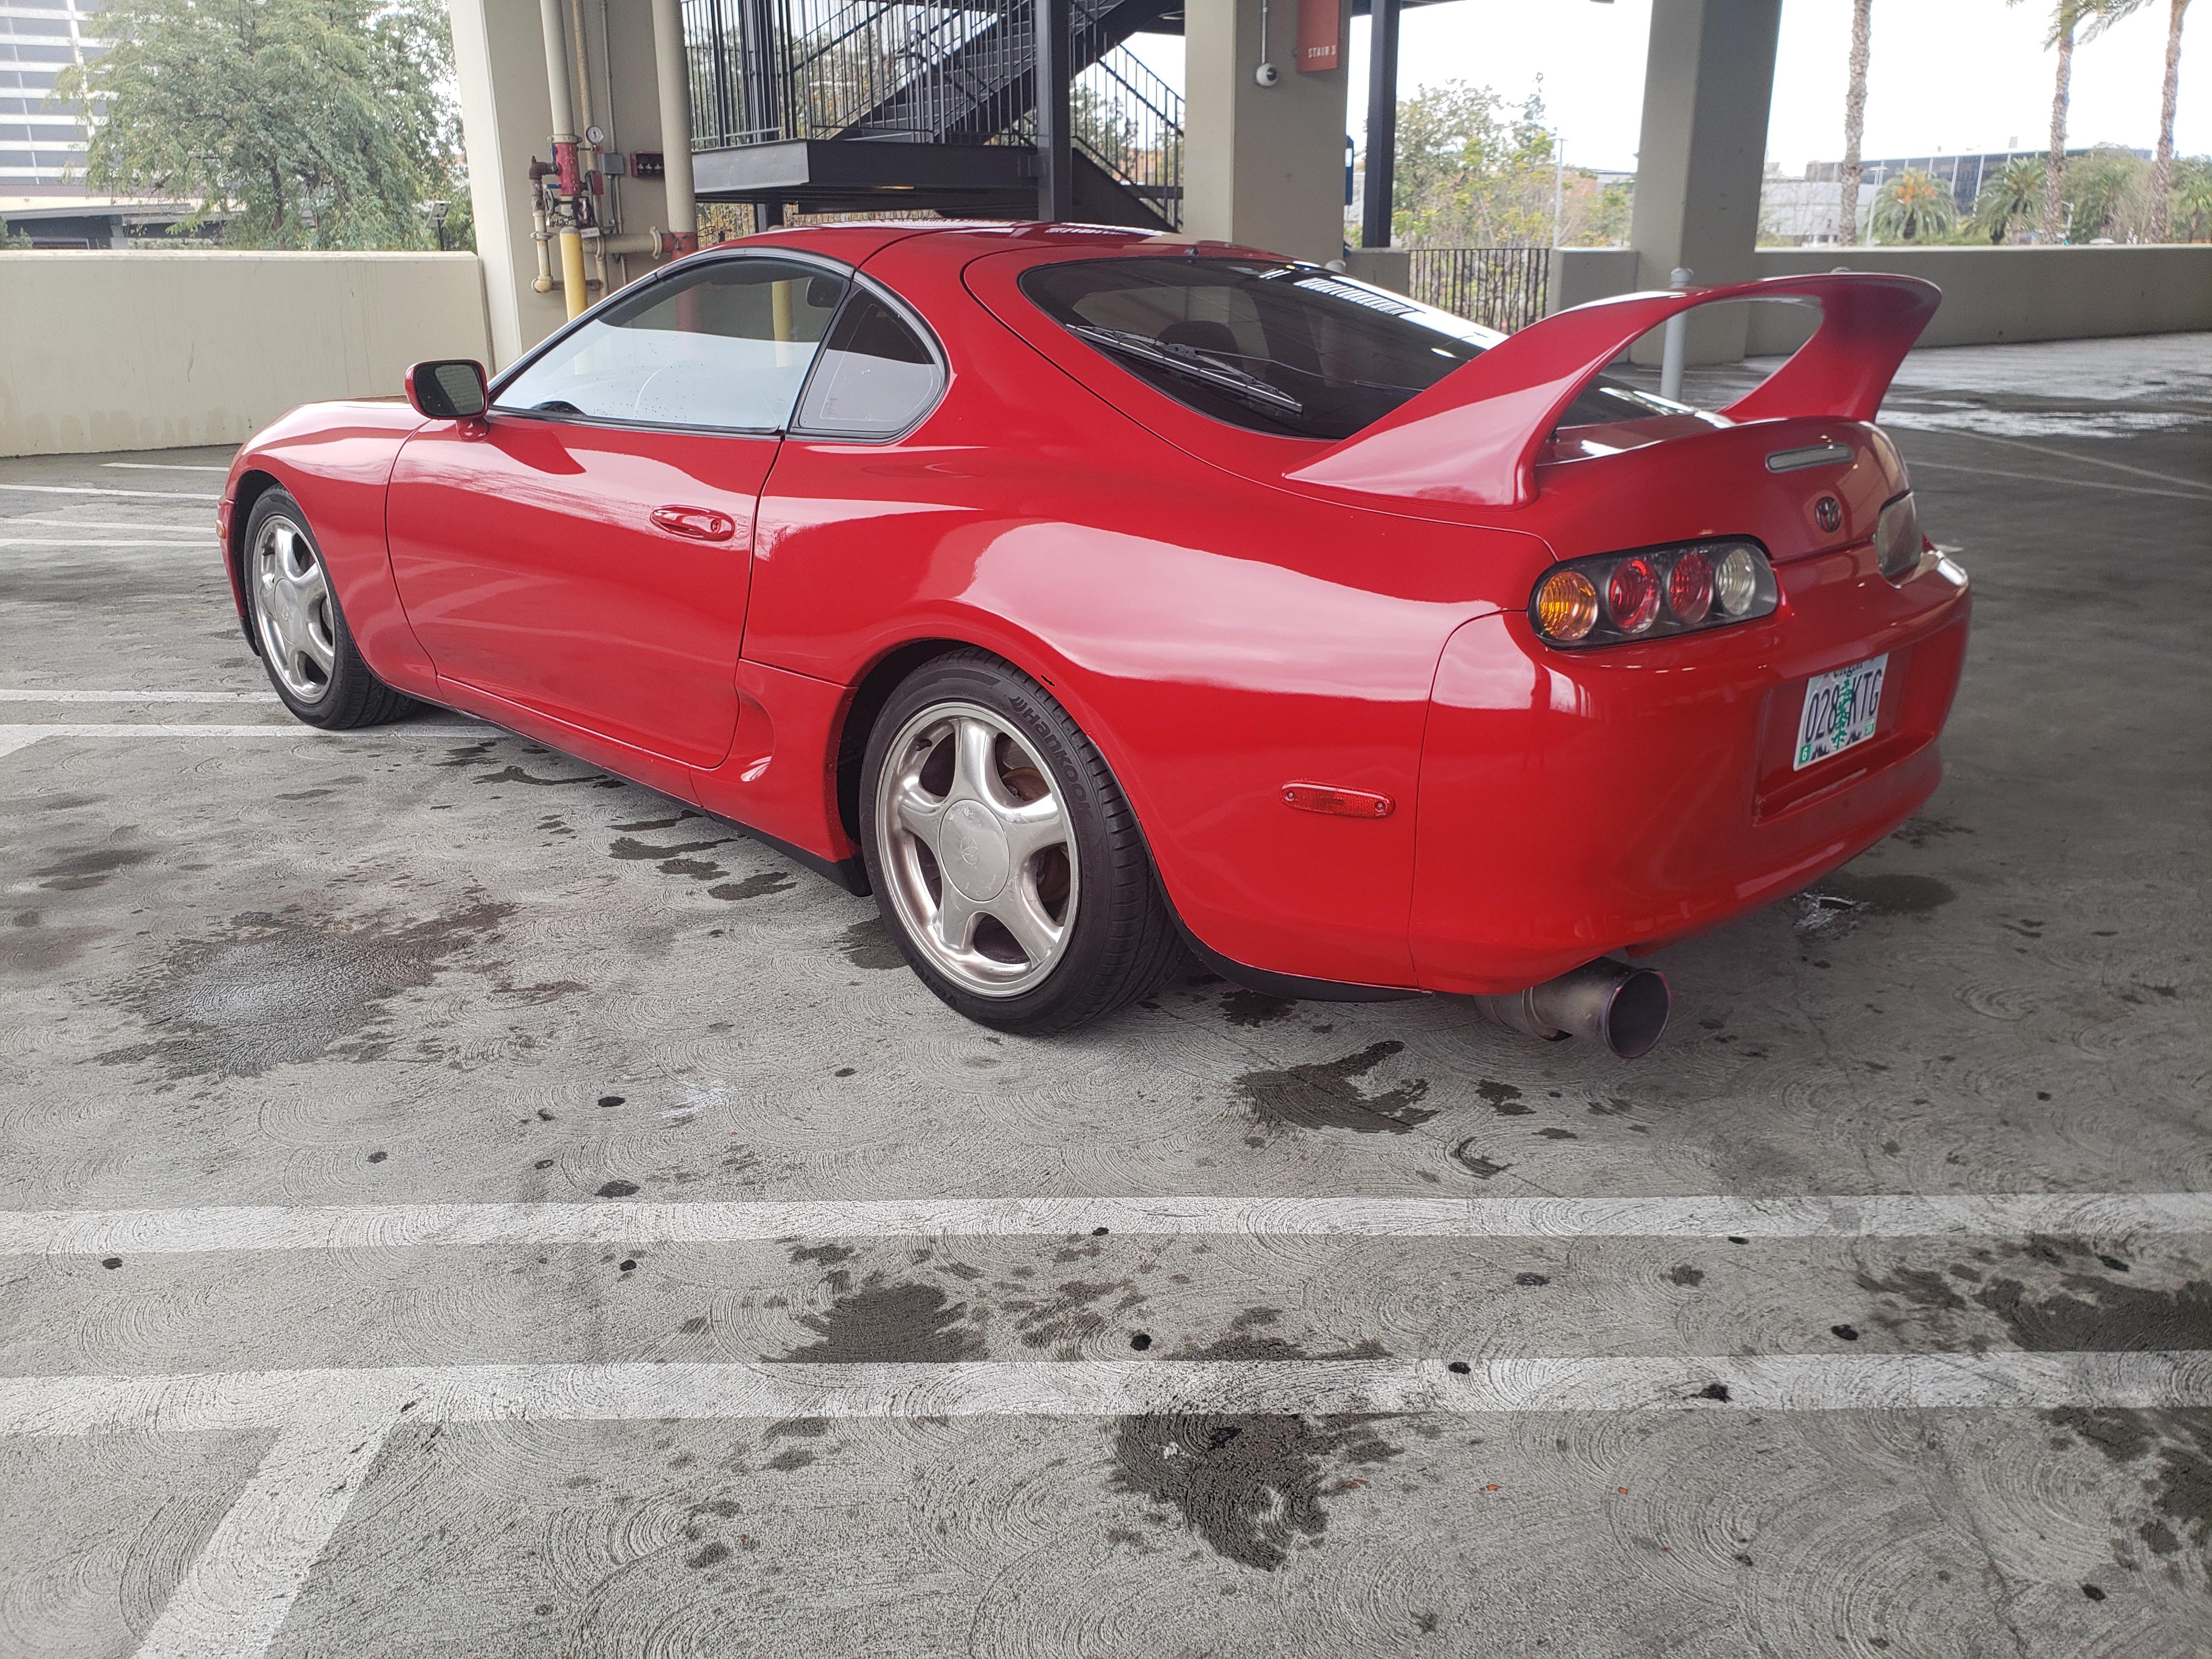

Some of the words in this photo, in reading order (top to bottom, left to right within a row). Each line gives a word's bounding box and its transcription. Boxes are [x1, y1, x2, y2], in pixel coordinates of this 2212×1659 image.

[1308, 46, 1330, 58] STAIR
[1805, 684, 1840, 743] 028
[1847, 669, 1882, 727] KTG
[1022, 707, 1093, 820] Hankook
[1802, 748, 1808, 761] 6
